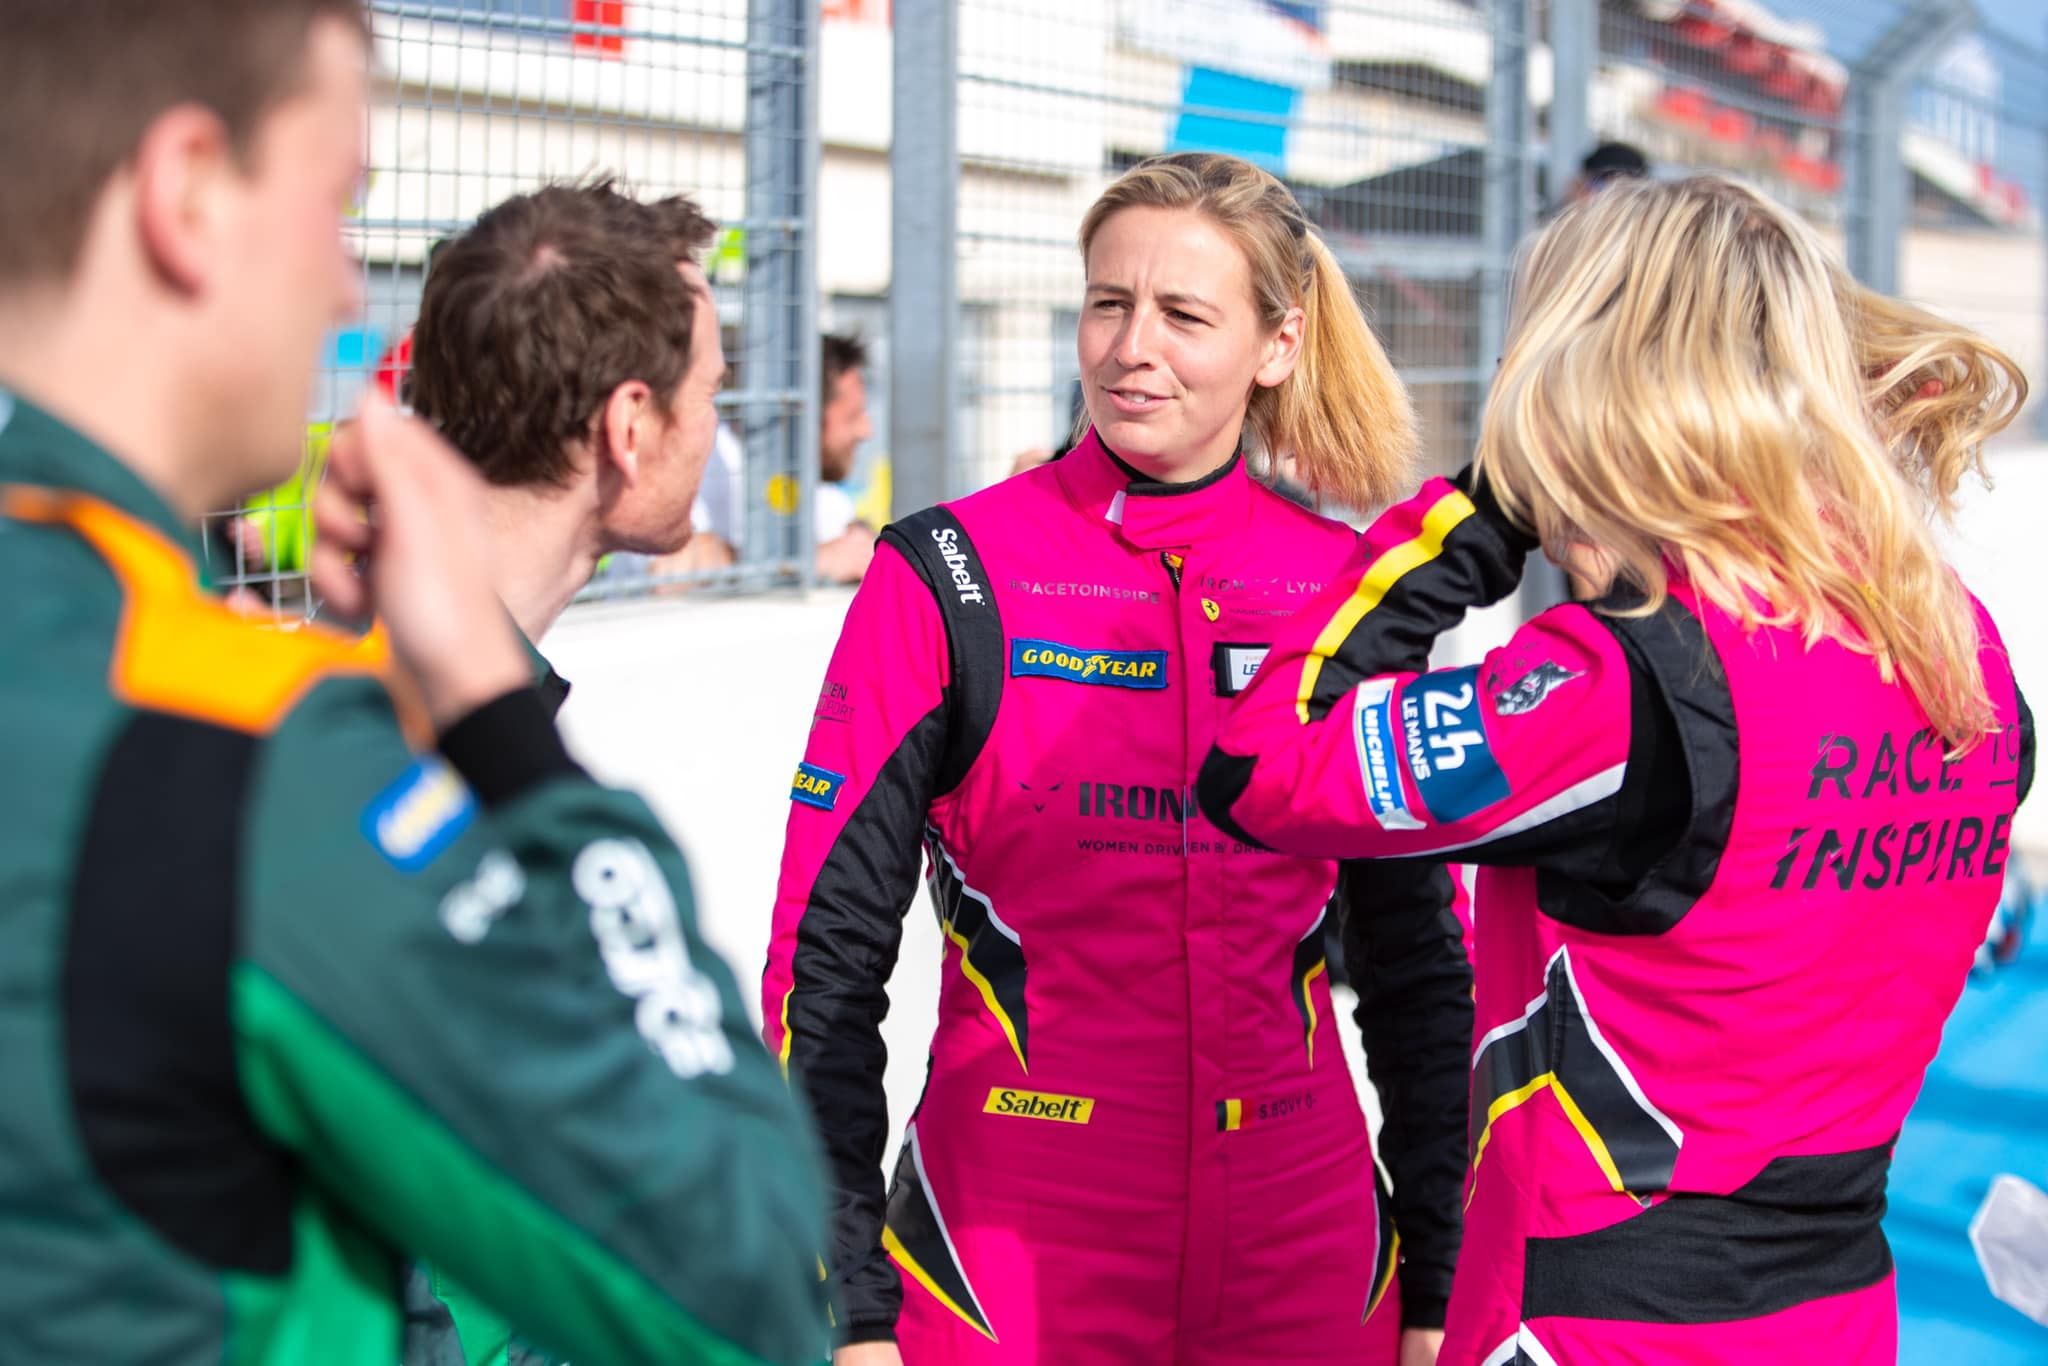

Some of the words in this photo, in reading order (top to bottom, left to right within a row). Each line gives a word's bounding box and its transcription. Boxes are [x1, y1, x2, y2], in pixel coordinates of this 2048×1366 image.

[931, 528, 983, 605] Sabelt
[1285, 578, 1329, 594] LYN
[1022, 648, 1157, 678] GOODYEAR
[1401, 697, 1419, 720] LE
[1424, 682, 1484, 771] 24h
[1405, 720, 1432, 781] MANS
[1077, 839, 1139, 854] WOMEN
[1769, 813, 2009, 891] INSPIRE
[996, 1090, 1082, 1120] Sabelt
